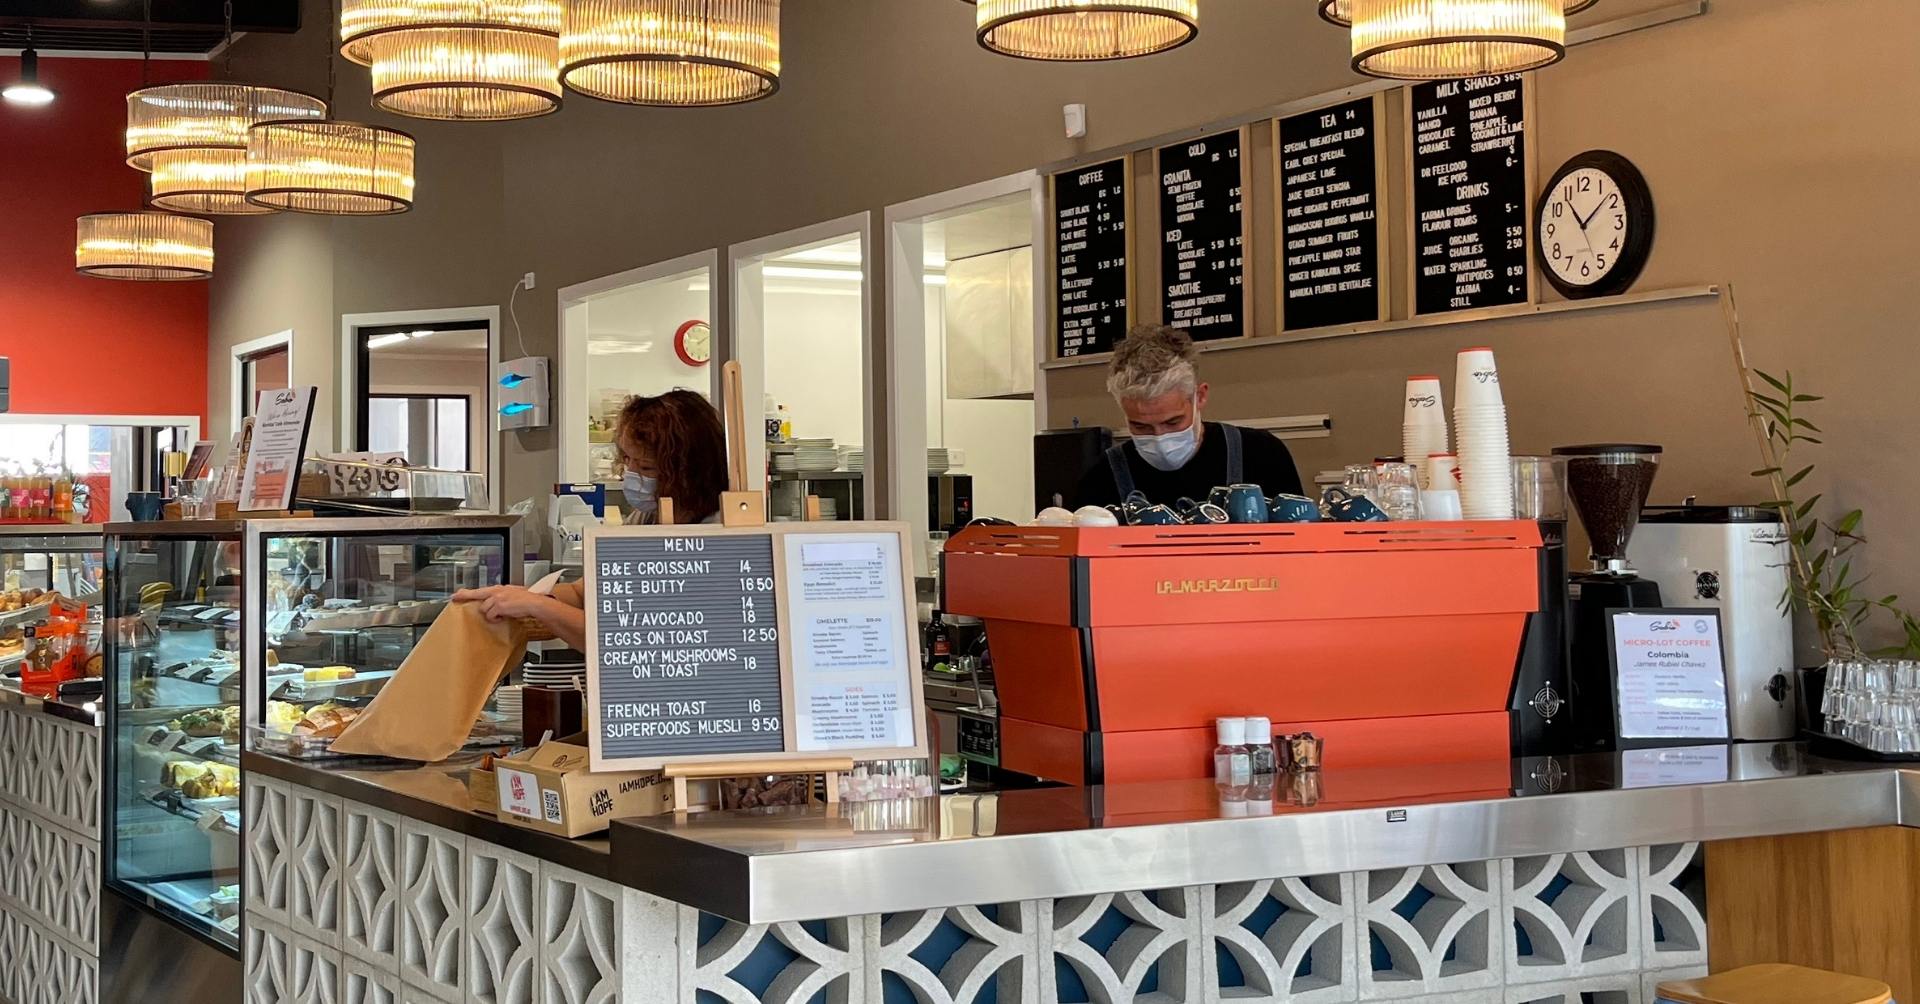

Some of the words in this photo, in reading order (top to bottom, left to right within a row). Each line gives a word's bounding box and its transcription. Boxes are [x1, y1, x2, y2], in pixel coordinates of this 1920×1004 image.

[1436, 81, 1460, 99] MILK
[1469, 95, 1492, 109] MIXED
[1494, 89, 1517, 103] BERRY
[1320, 113, 1336, 128] TEA
[1346, 109, 1355, 120] $4
[1417, 105, 1448, 121] VANILLA
[1469, 106, 1498, 121] BANANA
[1418, 118, 1442, 132] MANGO
[1470, 115, 1508, 133] PINEAPPLE
[1471, 126, 1500, 141] COCONUT
[1507, 120, 1524, 133] LIME
[1284, 140, 1308, 154] SPECIAL
[1309, 131, 1342, 148] BREAKFAST
[1343, 126, 1365, 140] BLEND
[1418, 126, 1456, 144] CHOCOLATE
[1188, 142, 1206, 157] COLD
[1418, 140, 1451, 155] CARAMEL
[1470, 135, 1516, 153] STRAWBERRY
[1284, 158, 1302, 170] EARL
[1302, 154, 1318, 166] GREY
[1320, 148, 1346, 162] SPECIAL
[1286, 170, 1317, 186] JAPANESE
[1320, 166, 1337, 179] LIME
[1421, 167, 1431, 178] DR
[1432, 160, 1468, 176] FEELGOOD
[1079, 170, 1103, 186] COFFEE
[1163, 169, 1191, 186] GRANITA
[1438, 175, 1449, 187] ICE
[1450, 171, 1469, 185] POPS
[1577, 177, 1590, 192] 12
[1287, 190, 1303, 202] JADE
[1304, 186, 1325, 198] GREEN
[1326, 180, 1351, 194] SENCHA
[1456, 182, 1489, 201] DRINKS
[1564, 185, 1573, 201] 11
[1287, 206, 1303, 218] PURE
[1304, 201, 1329, 214] ORGANIC
[1330, 193, 1370, 210] PEPPERMINT
[1609, 194, 1618, 209] 2
[1349, 209, 1375, 223] VANILLA
[1421, 208, 1446, 222] KARMA
[1446, 203, 1472, 217] DRINKS
[1552, 202, 1562, 218] 10
[1422, 219, 1451, 233] FLAVOUR
[1453, 214, 1478, 228] BOMBS
[1614, 214, 1624, 230] 3
[1166, 229, 1182, 243] ICED
[1307, 234, 1334, 247] SUMMER
[1337, 229, 1359, 242] FRUITS
[1547, 223, 1555, 238] 9
[1449, 232, 1479, 246] ORGANIC
[1609, 237, 1619, 251] 4
[1288, 252, 1321, 266] PINEAPPLE
[1322, 248, 1343, 261] MANGO
[1345, 245, 1361, 257] STAR
[1422, 243, 1443, 256] JUICE
[1449, 243, 1484, 258] CHARLIES
[1552, 242, 1561, 259] 8
[1423, 264, 1446, 277] WATER
[1449, 258, 1488, 273] SPARKLING
[1565, 256, 1573, 271] 7
[1581, 261, 1589, 276] 6
[1597, 254, 1605, 269] 5
[1288, 270, 1310, 282] GINGER
[1343, 262, 1361, 274] SPICE
[1455, 269, 1494, 284] ANTIPODES
[1168, 281, 1201, 297] SMOOTHIE
[1289, 286, 1314, 299] MANUKA
[1314, 283, 1337, 295] FLOWER
[1455, 283, 1481, 296] KARMA
[1450, 296, 1472, 308] STILL
[664, 538, 704, 552] MENU
[601, 561, 631, 576] B&E
[638, 560, 710, 575] CROISSANT
[740, 559, 751, 573] 14
[602, 581, 633, 595] B&E
[641, 579, 685, 594] BUTTY
[741, 596, 754, 610] 14
[641, 611, 704, 626] AVOCADO
[742, 610, 756, 623] 18
[604, 631, 641, 646] EGGS
[647, 631, 665, 645] ON
[669, 630, 709, 644] TOAST
[1623, 639, 1673, 647] MICRO-LOT
[1676, 639, 1711, 647] COFFEE
[603, 650, 657, 666] CREAMY
[661, 648, 737, 663] MUSHROOMS
[632, 664, 651, 679] ON
[658, 663, 700, 678] TOAST
[743, 656, 757, 670] 18
[607, 703, 660, 718] FRENCH
[666, 701, 707, 715] TOAST
[748, 699, 761, 713] 16
[606, 720, 691, 738] SUPERFOODS
[698, 719, 742, 734] MUESLI
[592, 799, 613, 817] HOPE
